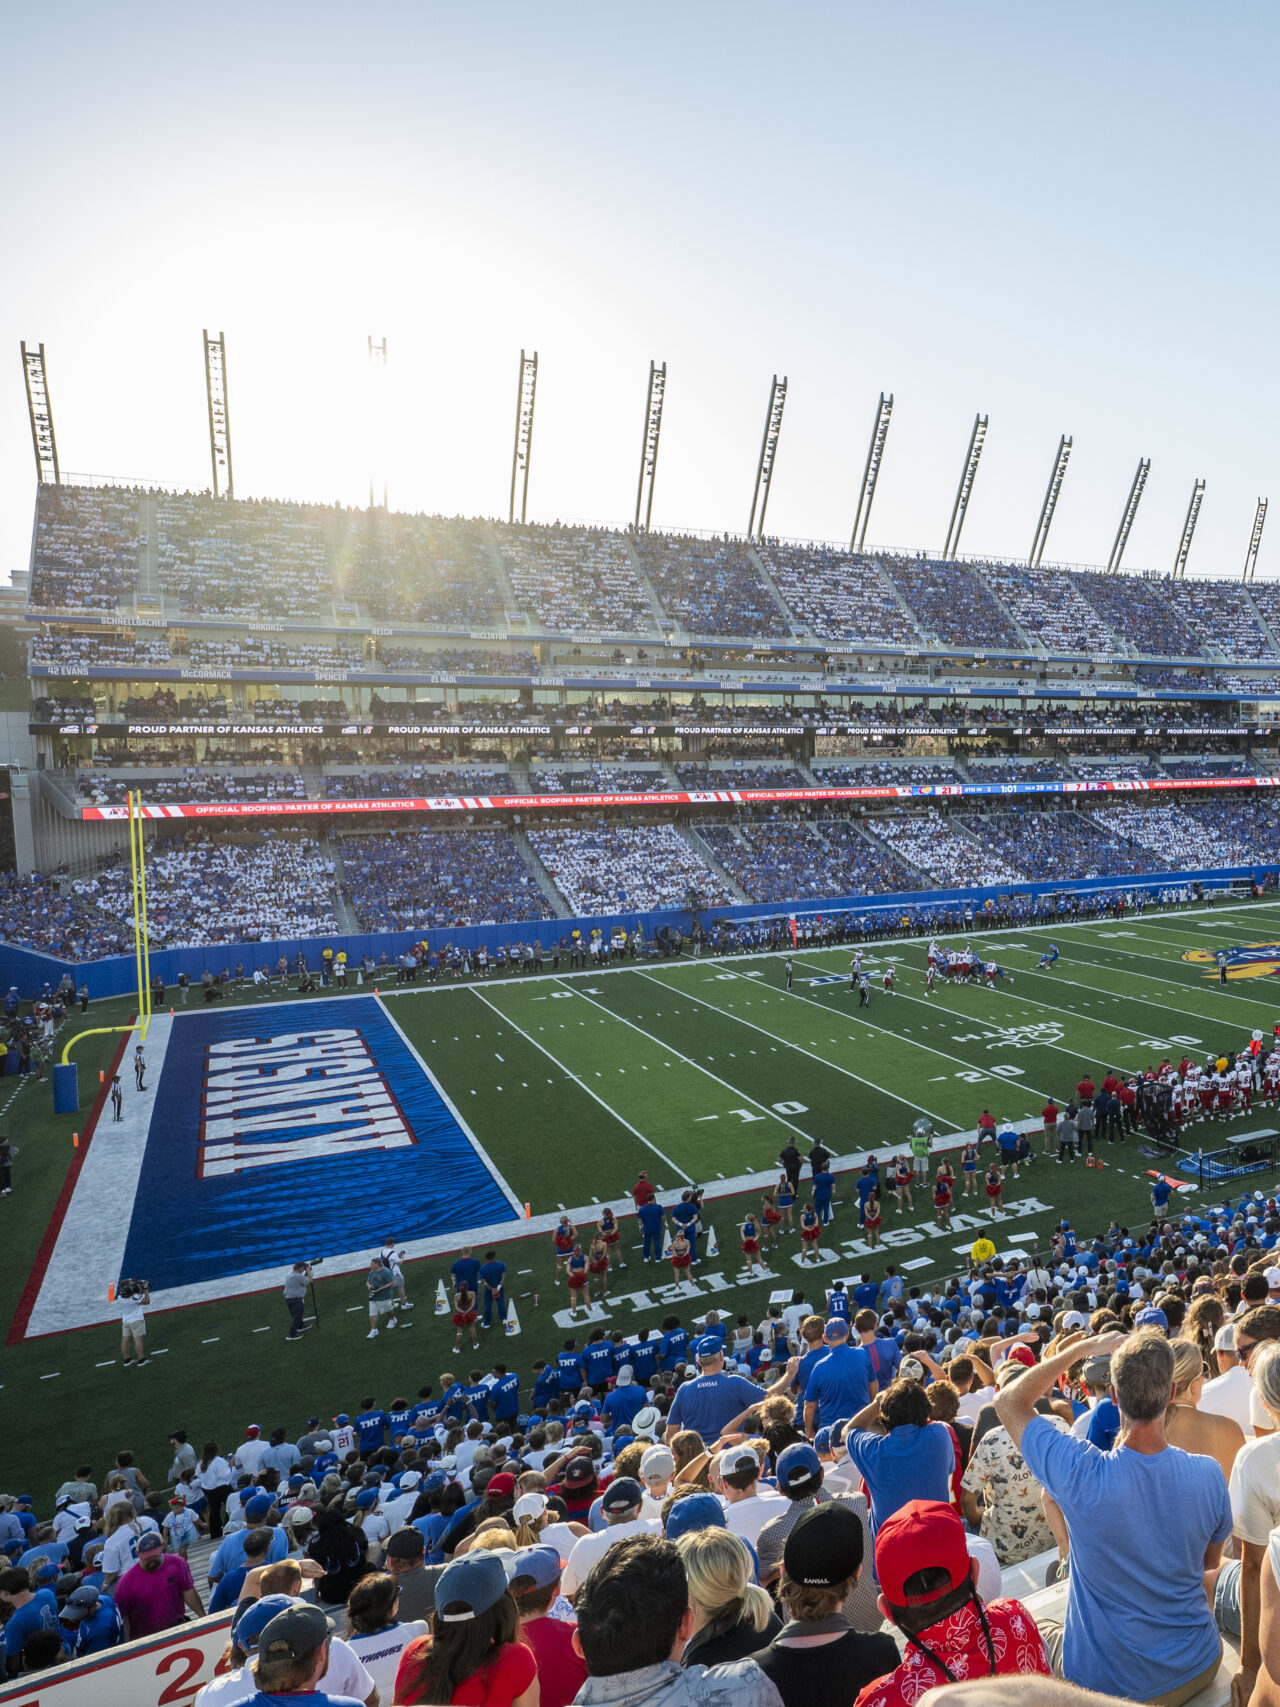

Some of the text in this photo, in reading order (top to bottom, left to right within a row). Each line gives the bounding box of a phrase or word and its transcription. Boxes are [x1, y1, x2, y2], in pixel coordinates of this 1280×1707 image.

[101, 618, 168, 628] SCHNELLBACHER
[62, 667, 89, 676] EVANS
[181, 670, 232, 678] McCORMACK
[128, 726, 323, 734] PROUD PARTNER OF KANSAS ATHLETICS
[1138, 1035, 1203, 1050] 30
[954, 1064, 1026, 1084] 20
[197, 1028, 419, 1180] KANSAS
[728, 1100, 809, 1123] 10
[552, 1196, 1054, 1328] KIVISTO FIELD
[833, 1301, 843, 1312] 11
[670, 1332, 688, 1344] TNT
[591, 1349, 609, 1359] TNT
[613, 1350, 630, 1360] TNT
[636, 1346, 657, 1358] TNT
[559, 1358, 576, 1367] TNT
[501, 1379, 519, 1392] TNT
[468, 1390, 487, 1401] TNT
[417, 1406, 438, 1417] TNT
[360, 1417, 380, 1429] TNT
[338, 1437, 350, 1448] 21
[1014, 1530, 1040, 1550] ALOHA
